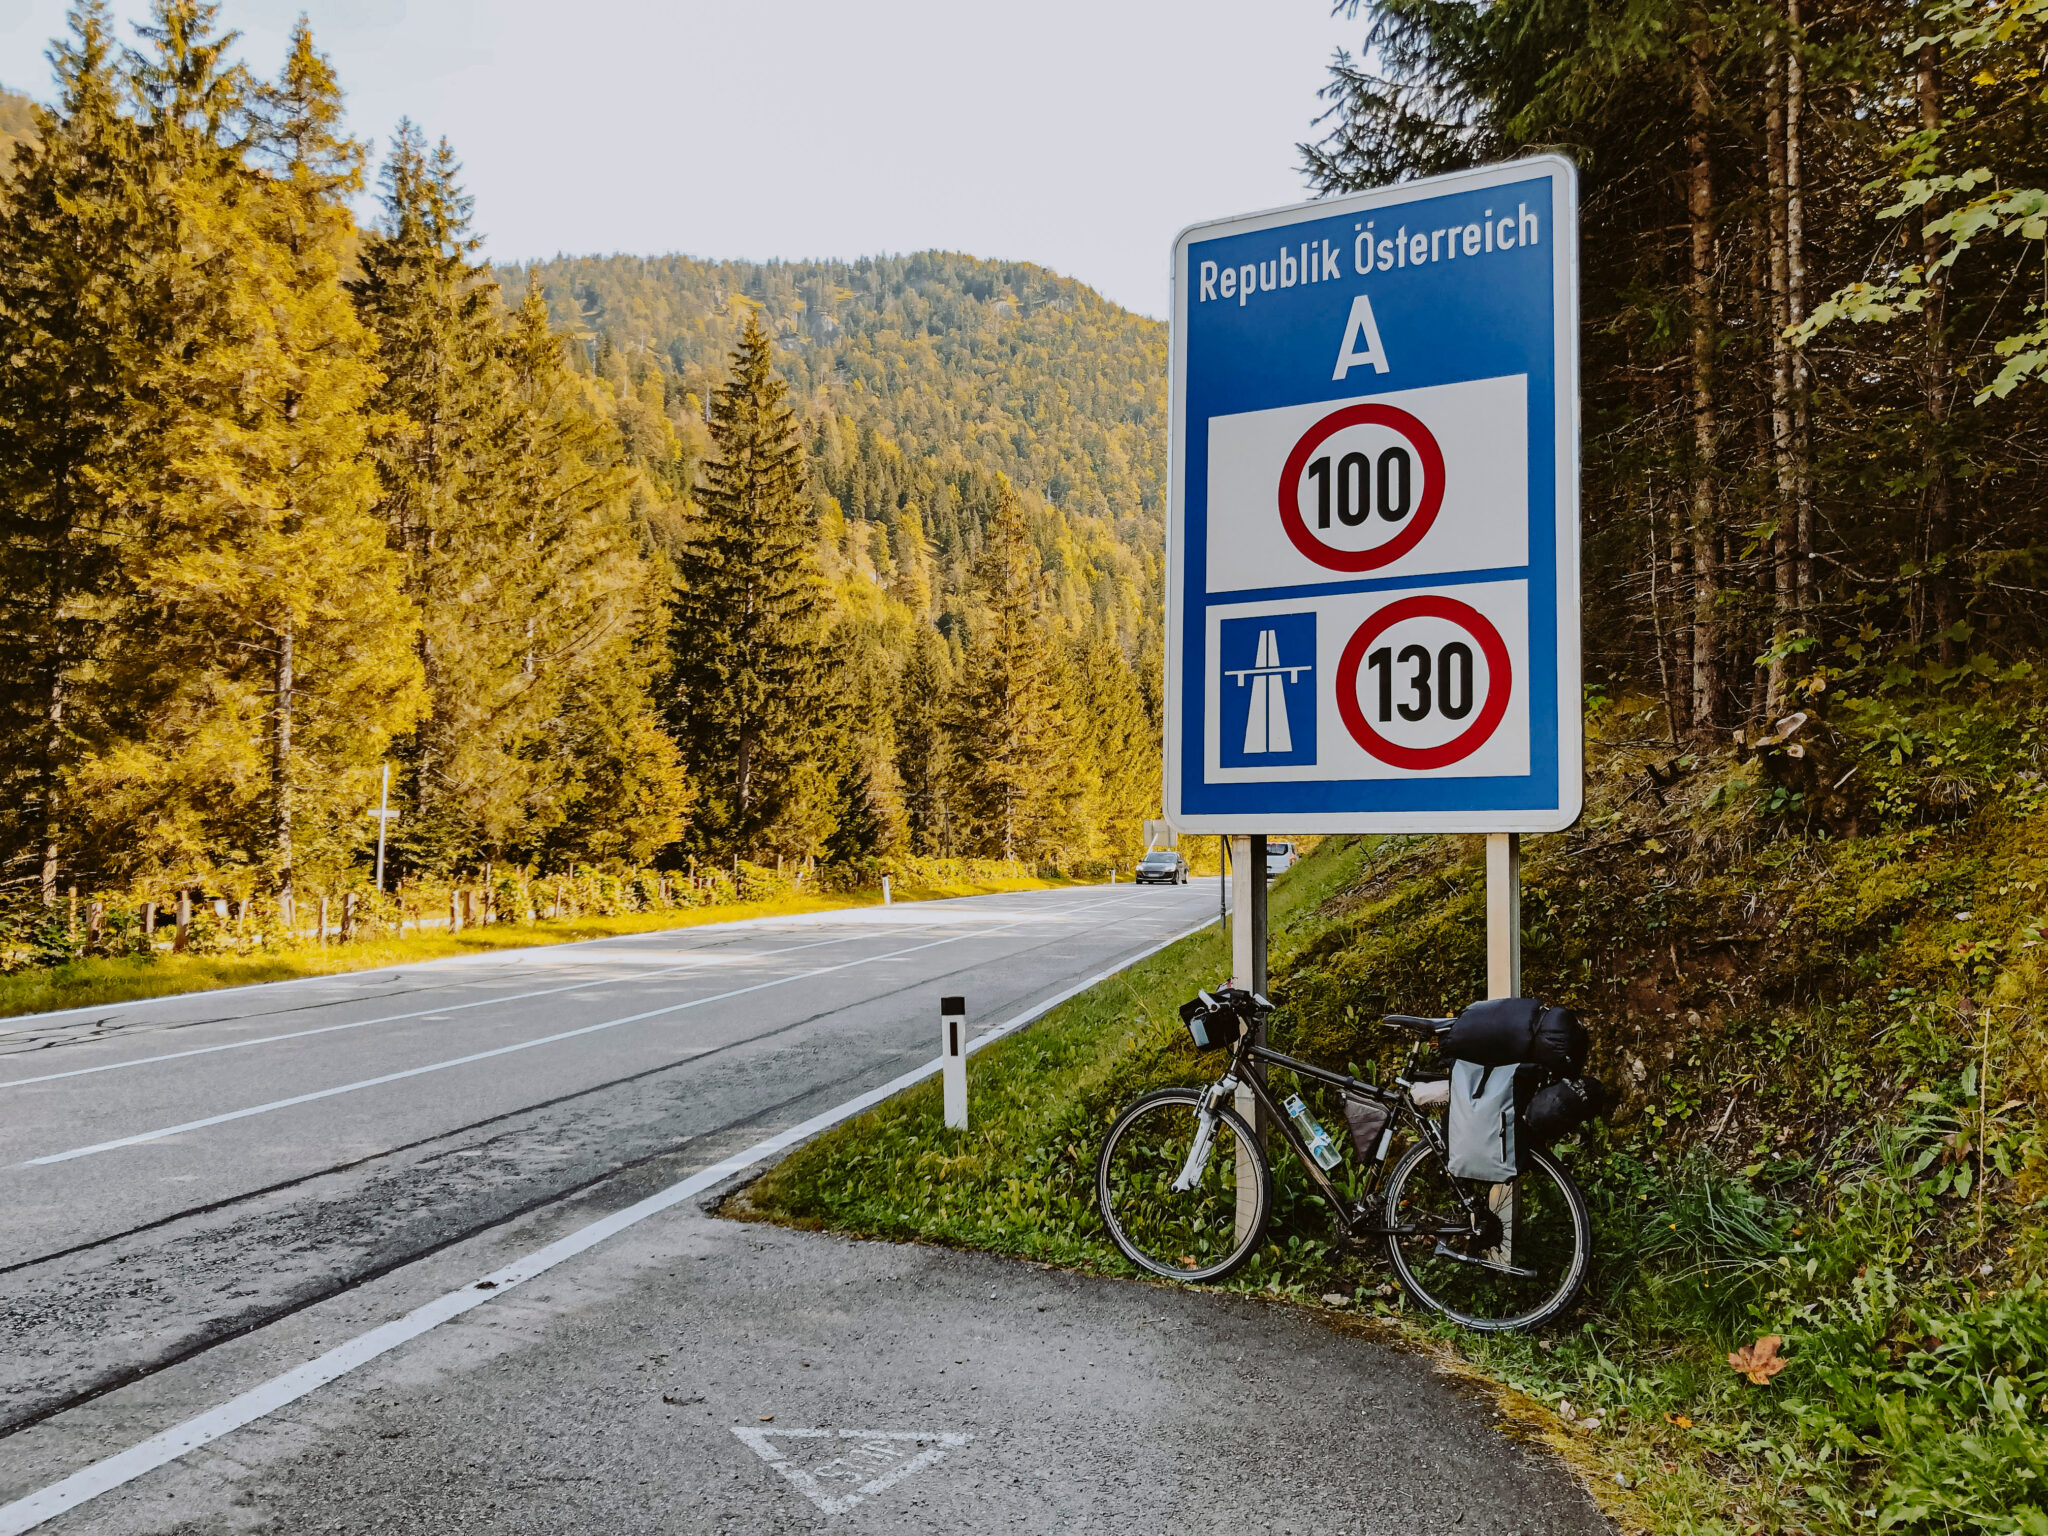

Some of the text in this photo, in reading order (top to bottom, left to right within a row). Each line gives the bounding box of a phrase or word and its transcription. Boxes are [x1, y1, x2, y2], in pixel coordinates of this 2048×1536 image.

[1200, 203, 1539, 306] Republik Österreich
[1332, 294, 1390, 381] A
[1308, 446, 1411, 529] 100
[1368, 641, 1474, 722] 130
